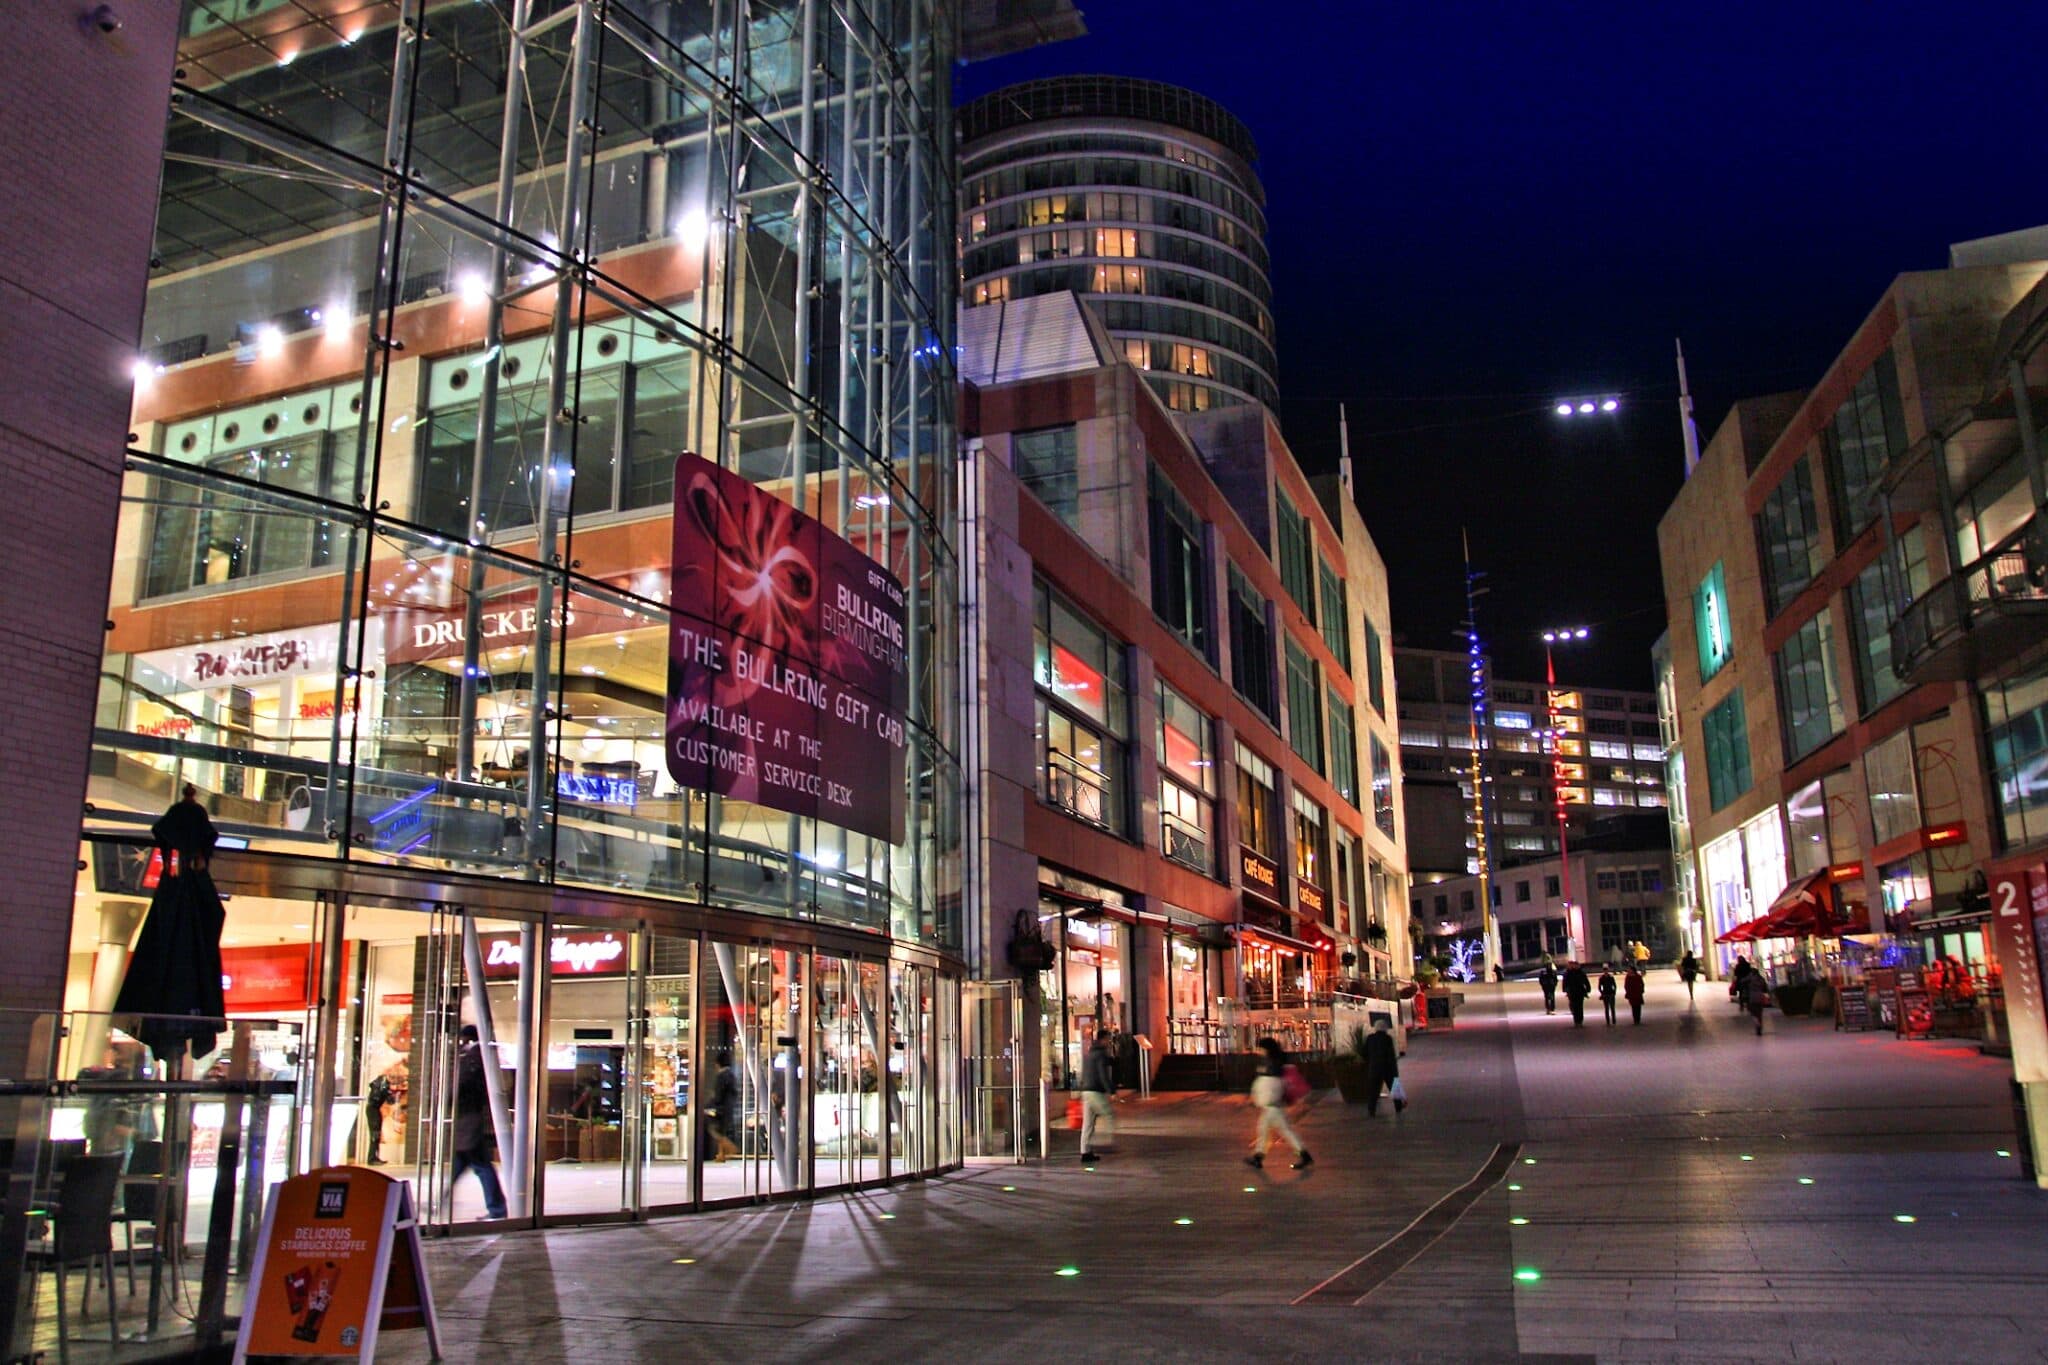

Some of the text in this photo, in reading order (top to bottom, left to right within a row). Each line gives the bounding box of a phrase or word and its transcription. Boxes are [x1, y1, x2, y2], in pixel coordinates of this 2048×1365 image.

[867, 569, 904, 608] GIFT CARD
[837, 583, 903, 649] BULLRING
[822, 602, 903, 673] BIRMINGHAM
[679, 628, 904, 749] THE BULLRING GIFT CARD
[677, 697, 823, 762] AVAILABLE AT THE
[675, 735, 853, 808] CUSTOMER SERVICE DESK
[1996, 881, 2020, 917] 2
[645, 980, 689, 993] OFFEE
[321, 1192, 343, 1208] VIA
[280, 1239, 368, 1251] STARBUCKS COFFEE
[295, 1227, 353, 1240] DELICIOUS
